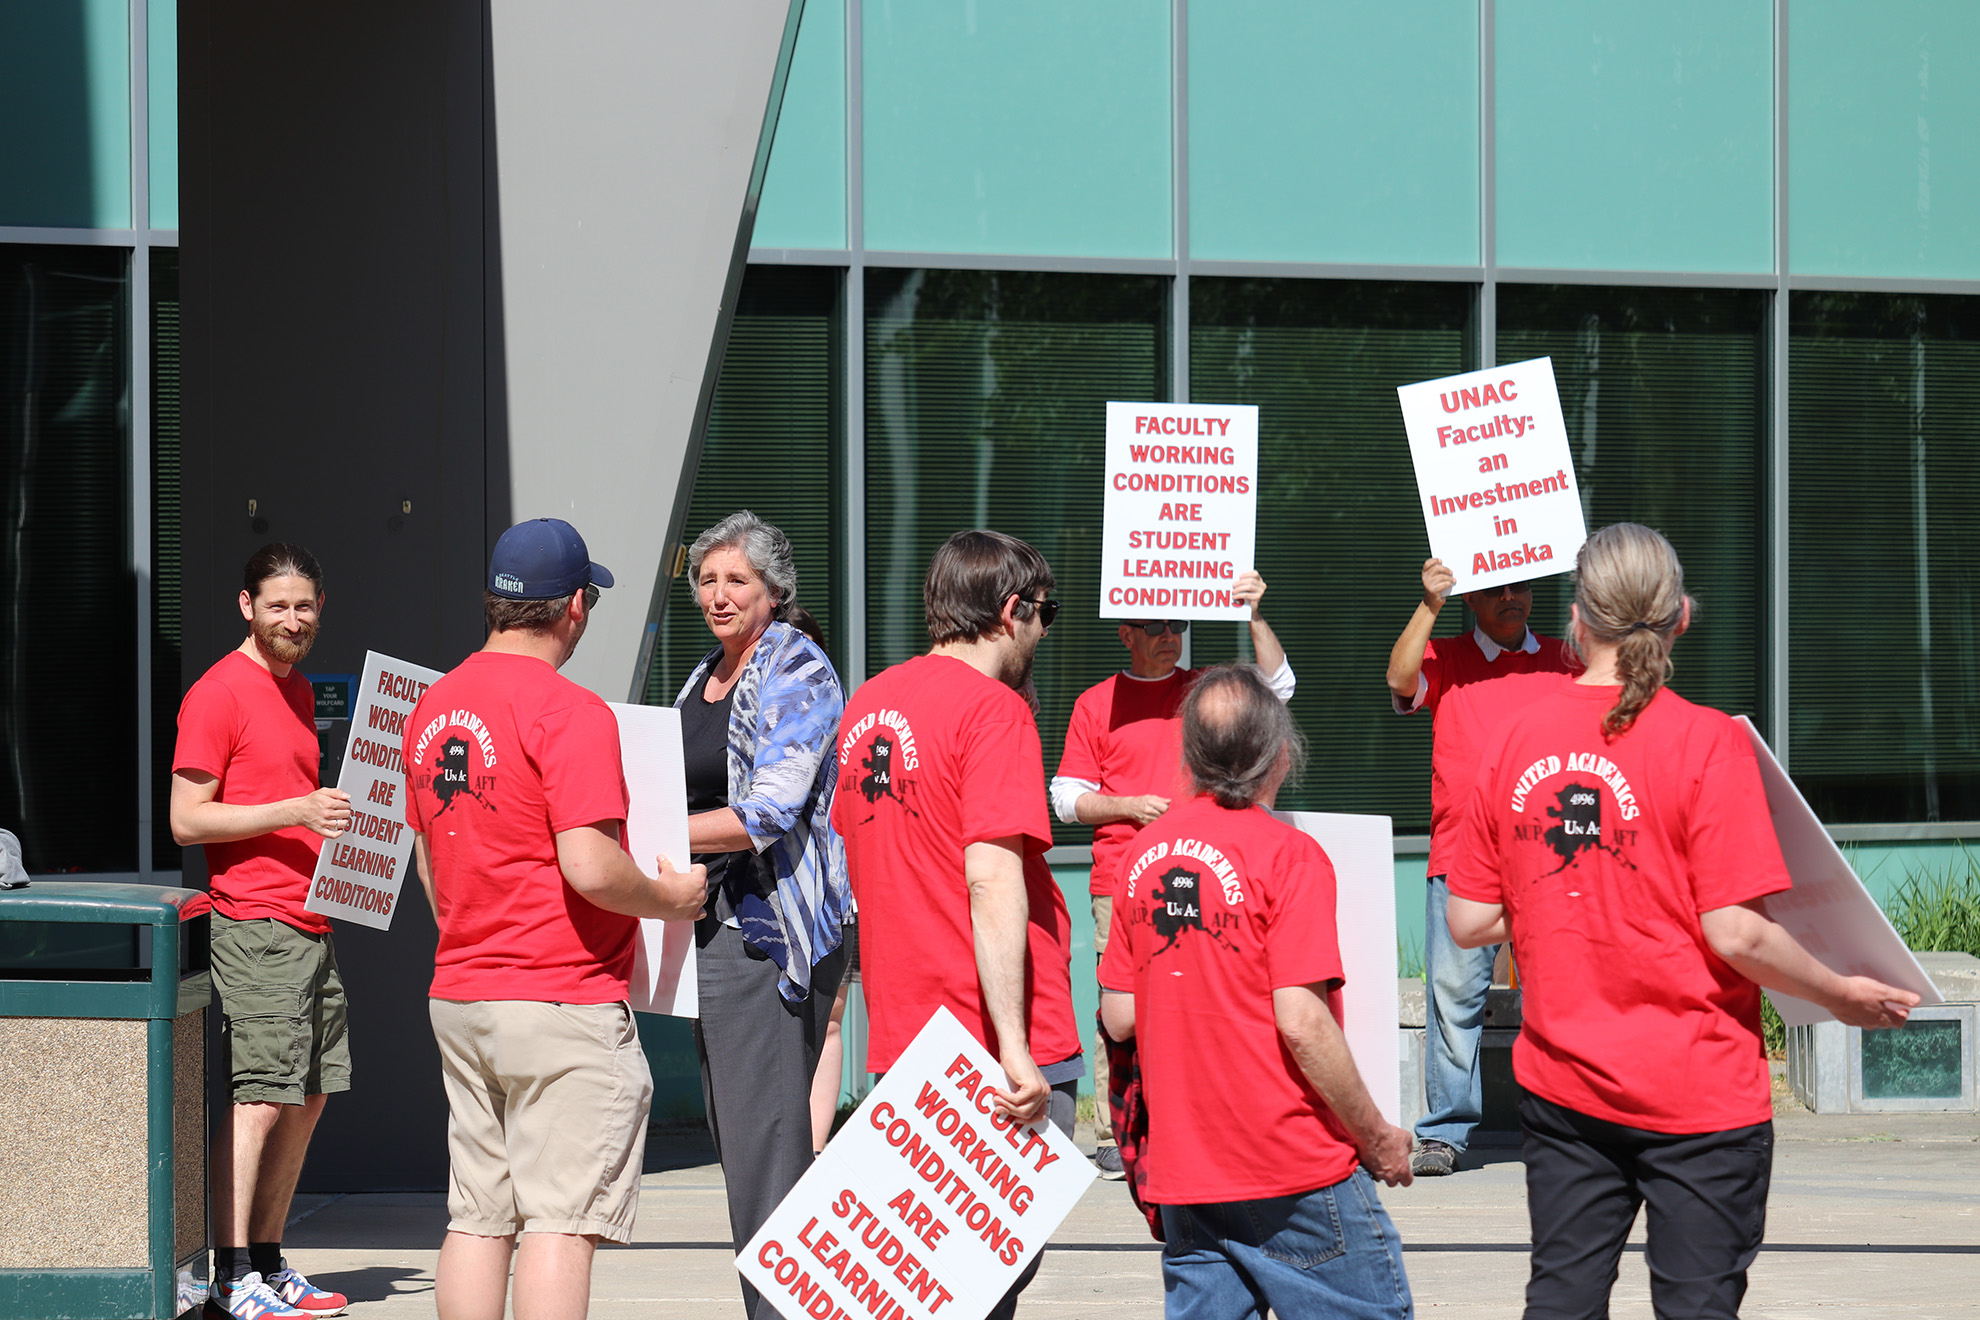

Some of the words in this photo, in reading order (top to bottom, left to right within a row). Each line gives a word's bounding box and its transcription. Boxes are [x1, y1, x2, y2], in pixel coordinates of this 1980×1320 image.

[1440, 379, 1518, 414] UNAC
[1135, 416, 1231, 436] FACULTY
[1437, 413, 1535, 448] Faculty:
[1130, 445, 1234, 465] WORKING
[1479, 451, 1508, 473] an
[1113, 473, 1250, 494] CONDITIONS
[1430, 470, 1569, 517] Investment
[1158, 503, 1202, 522] ARE
[1494, 515, 1518, 537] in
[1128, 531, 1231, 550] STUDENT
[1123, 559, 1234, 579] LEARNING
[1472, 542, 1553, 575] Alaska
[495, 575, 524, 593] KRAKEN
[377, 670, 430, 704] FACULT
[414, 714, 447, 765] UNITED
[449, 709, 497, 768] ACADEMICS
[840, 712, 876, 765] UNITED
[367, 779, 396, 807] ARE
[475, 776, 496, 790] AFT
[1511, 755, 1561, 813] UNITED
[1566, 752, 1640, 820] ACADEMICS
[344, 809, 404, 845] STUDENT
[331, 843, 396, 880] LEARNING
[1128, 842, 1168, 898] UNITED
[1171, 838, 1244, 905] ACADEMICS
[315, 876, 394, 915] CONDITIONS
[1172, 876, 1194, 888] 4996
[1212, 913, 1242, 929] AFT
[945, 1053, 1060, 1173] FACULTY
[914, 1080, 1034, 1216] WORKING
[870, 1101, 1024, 1266] CONDITIONS
[888, 1188, 950, 1252] ARE
[832, 1189, 954, 1314] STUDENT
[278, 1281, 305, 1305] N
[758, 1240, 853, 1320] COND
